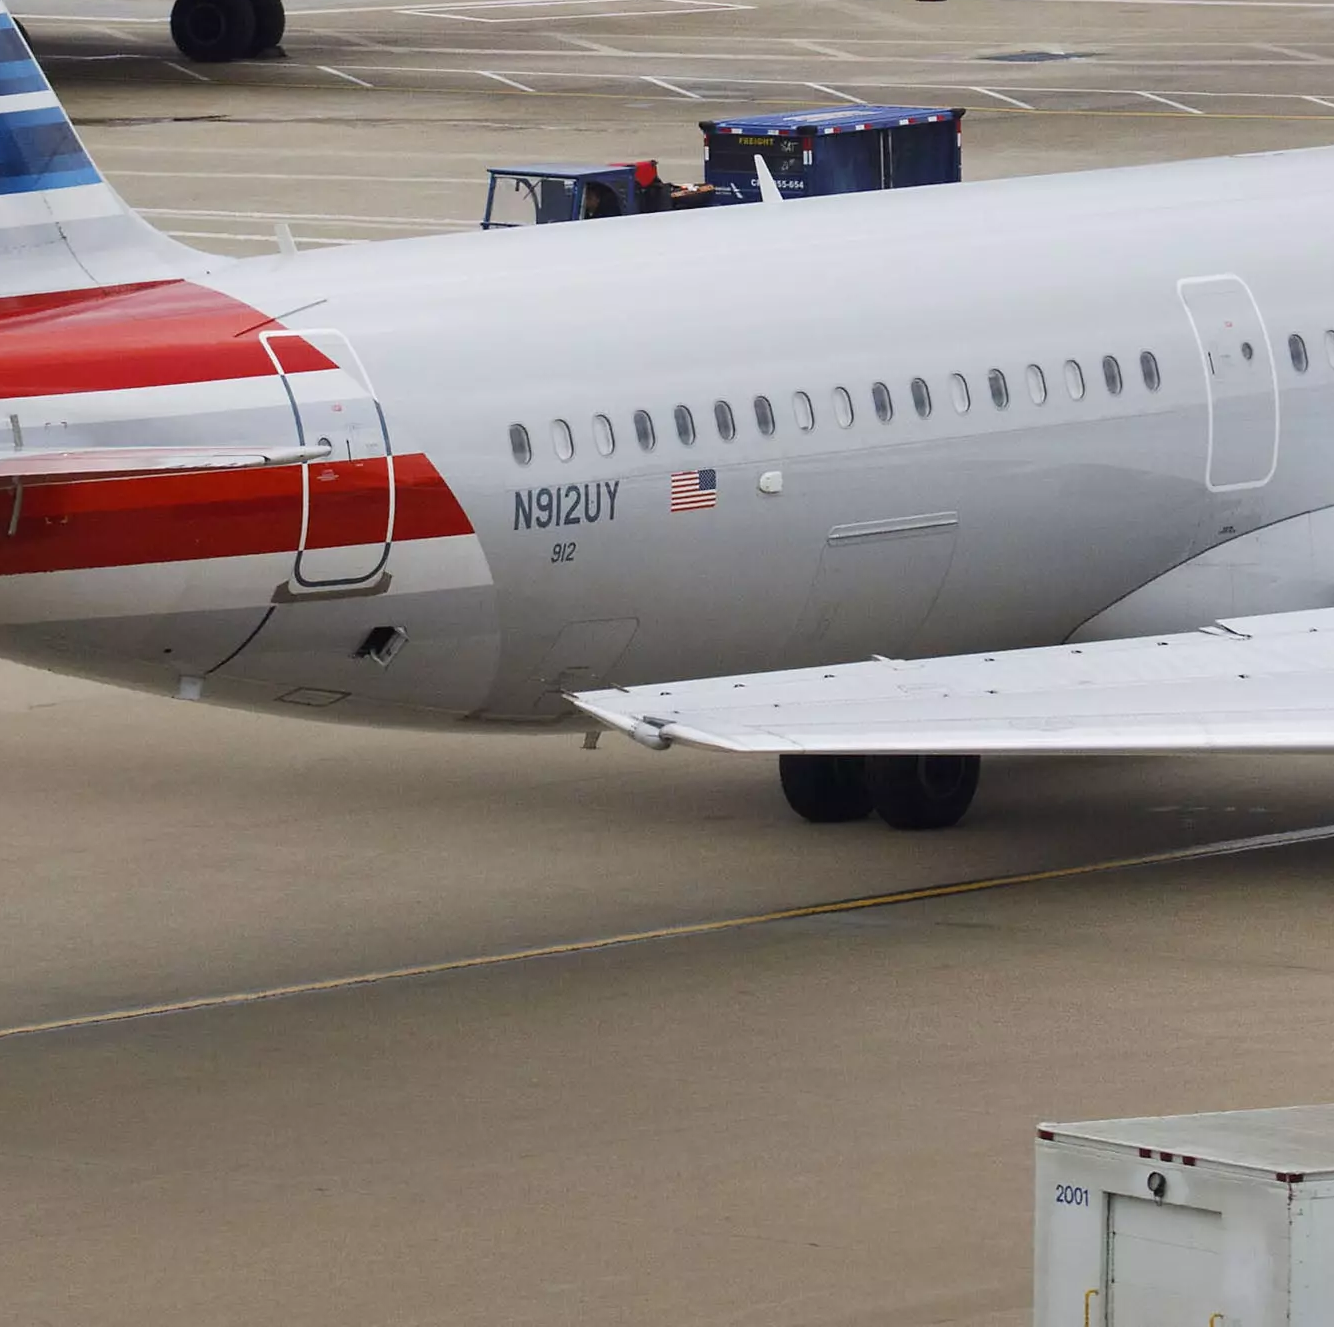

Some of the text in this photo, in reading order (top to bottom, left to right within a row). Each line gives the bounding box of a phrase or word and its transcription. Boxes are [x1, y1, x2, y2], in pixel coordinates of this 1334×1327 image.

[738, 137, 775, 146] FREIGHT
[514, 481, 619, 530] N912UY
[551, 542, 576, 563] 912
[1056, 1184, 1089, 1207] 2001
